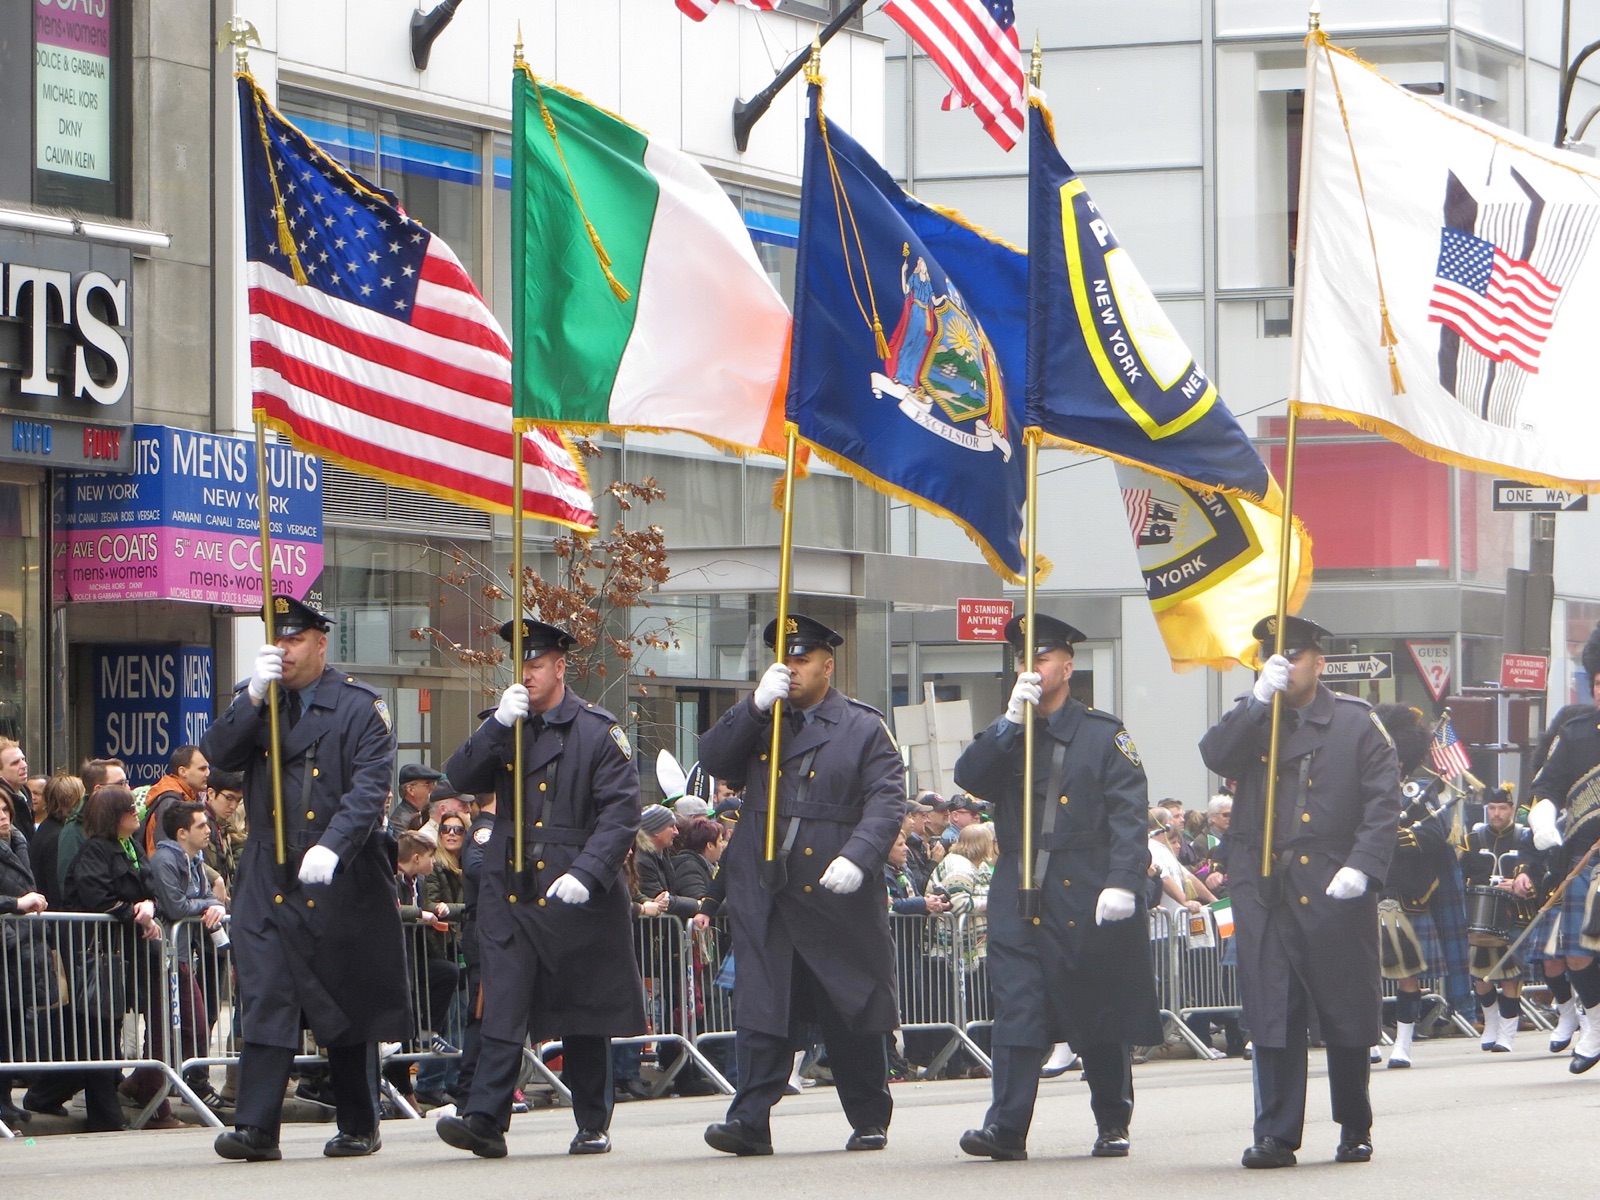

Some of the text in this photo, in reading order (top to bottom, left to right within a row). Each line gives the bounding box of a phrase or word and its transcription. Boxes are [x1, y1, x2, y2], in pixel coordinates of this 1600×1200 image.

[64, 55, 69, 72] &
[71, 57, 105, 80] GABBANA
[43, 83, 98, 110] MICHAEL KORS
[58, 118, 82, 138] DKNY
[45, 145, 95, 170] CALVIN KLEIN
[0, 263, 130, 405] TS
[1093, 279, 1143, 384] NEW YORK
[914, 410, 979, 448] EXCELSIOR
[13, 420, 121, 460] NYPD FDNY
[173, 434, 248, 483] MENS
[77, 485, 104, 501] NEW
[107, 483, 139, 500] YORK
[203, 487, 241, 508] NEW
[1506, 489, 1571, 502] ONE WAY
[101, 511, 119, 523] ZEGNA
[121, 510, 135, 522] BOSS
[137, 509, 160, 521] VERSACE
[172, 510, 317, 538] ARMANI CANALI ZEGNA OSS VERSACE
[73, 533, 158, 563] AVE COATS
[193, 540, 223, 562] AVE
[228, 538, 307, 577] COATS
[73, 564, 158, 581] mens womens
[190, 570, 229, 588] mens
[1156, 554, 1208, 588] YORK
[74, 593, 91, 601] DOLCE
[98, 592, 122, 600] GABBANA
[125, 590, 143, 599] CALVIN
[144, 590, 158, 598] KLEIN
[89, 581, 143, 591] MICHAEL KORS DKNY
[170, 586, 190, 599] MICHAEL
[191, 588, 203, 599] KORS
[206, 590, 219, 601] DKNY
[221, 592, 237, 602] DOLCE
[242, 594, 263, 605] GABBANA
[310, 589, 322, 600] 2nd
[961, 604, 1009, 615] NO STANDING
[967, 615, 1003, 625] ANYTIME
[1418, 648, 1448, 658] GUES
[1327, 662, 1379, 674] ONE WAY
[1509, 668, 1538, 677] ANYTIME
[1516, 659, 1544, 669] STANDING
[102, 654, 175, 699] MENS
[183, 655, 211, 699] MENS
[106, 711, 170, 756] SUITS
[136, 763, 170, 780] YORK
[171, 974, 179, 1025] NYPD
